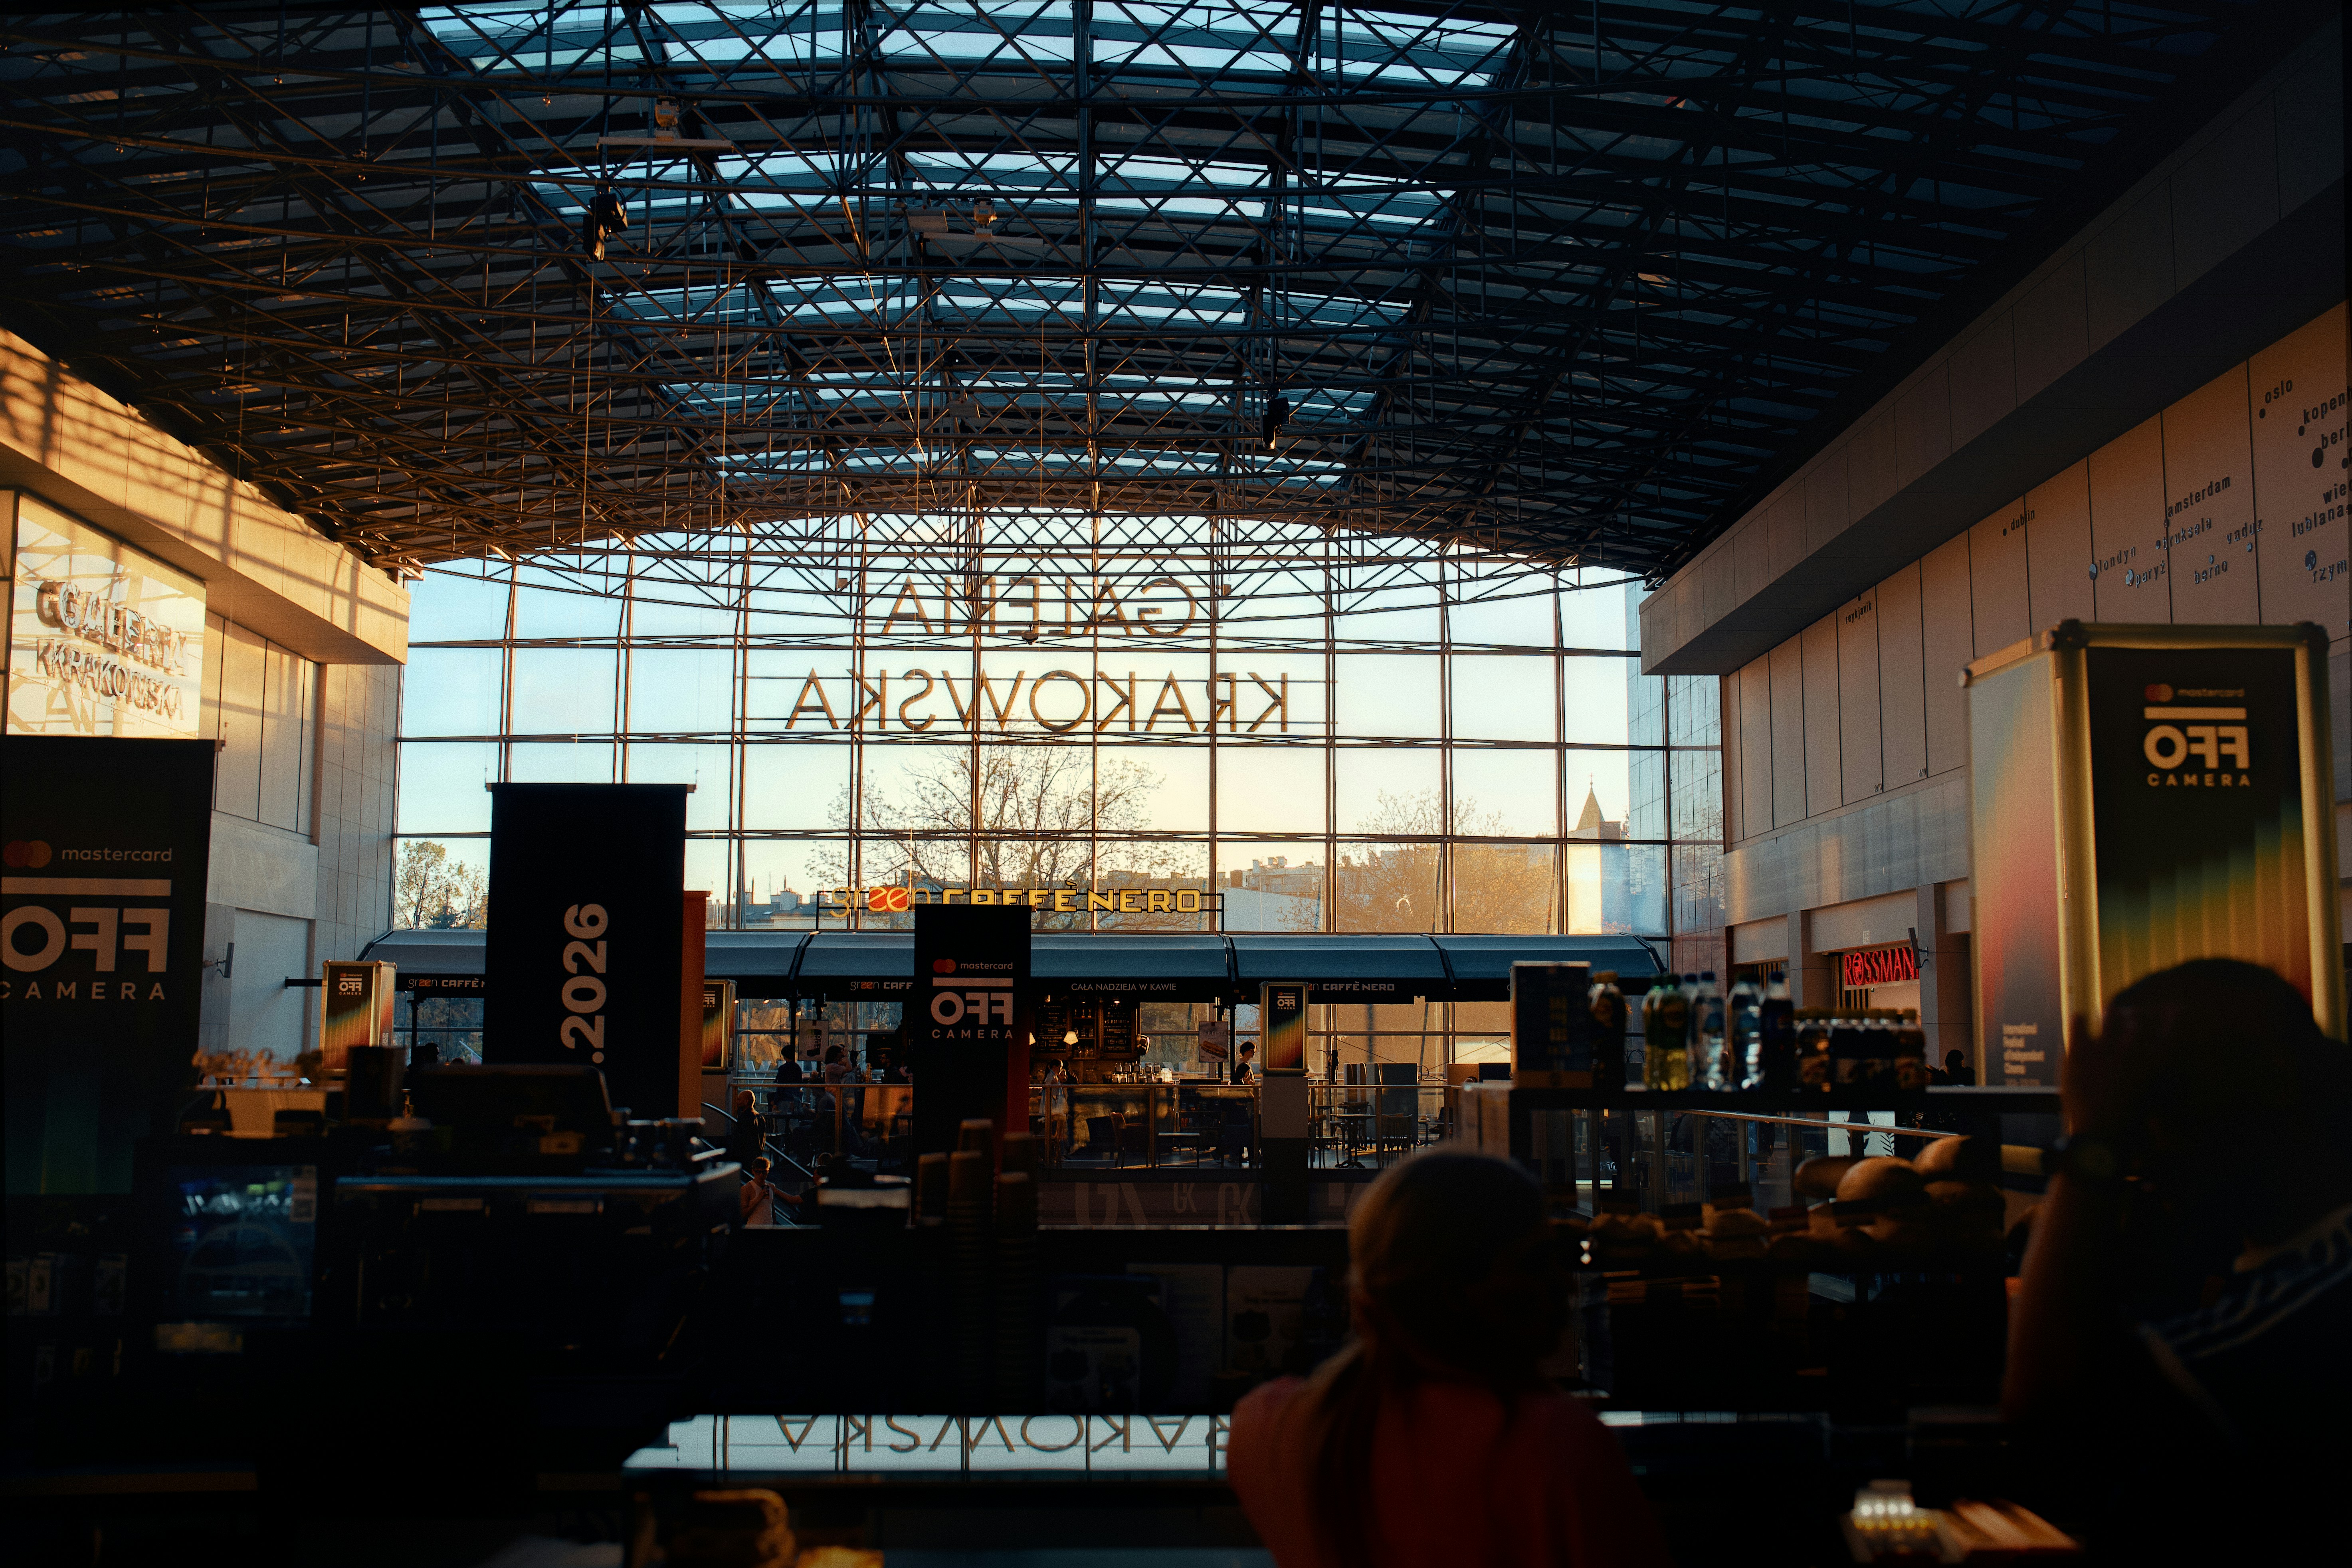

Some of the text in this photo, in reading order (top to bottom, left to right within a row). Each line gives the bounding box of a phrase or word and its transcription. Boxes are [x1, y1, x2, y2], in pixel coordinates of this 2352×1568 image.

[2265, 380, 2293, 404] oslo
[2168, 476, 2230, 517] amsterdam
[2011, 510, 2035, 531] dublin
[2226, 519, 2263, 544] vaduz
[2292, 505, 2344, 537] lublana
[2162, 518, 2211, 550] bruksela
[2099, 547, 2135, 572] londyn
[2313, 560, 2347, 583] rzym
[2136, 560, 2165, 588] paryż
[2194, 560, 2227, 584] berno
[1845, 600, 1872, 624] reykjavik
[2143, 724, 2250, 770] OFF
[2147, 772, 2251, 787] CAMERA
[62, 847, 172, 862] mastercard
[830, 887, 931, 917] green
[1087, 889, 1201, 913] NERO
[408, 979, 437, 988] green
[441, 978, 479, 988] CAFFÈ
[850, 981, 879, 991] green
[1323, 981, 1360, 991] CAFFÈ
[931, 992, 1014, 1026] OFF
[932, 1029, 1013, 1039] CAMERA
